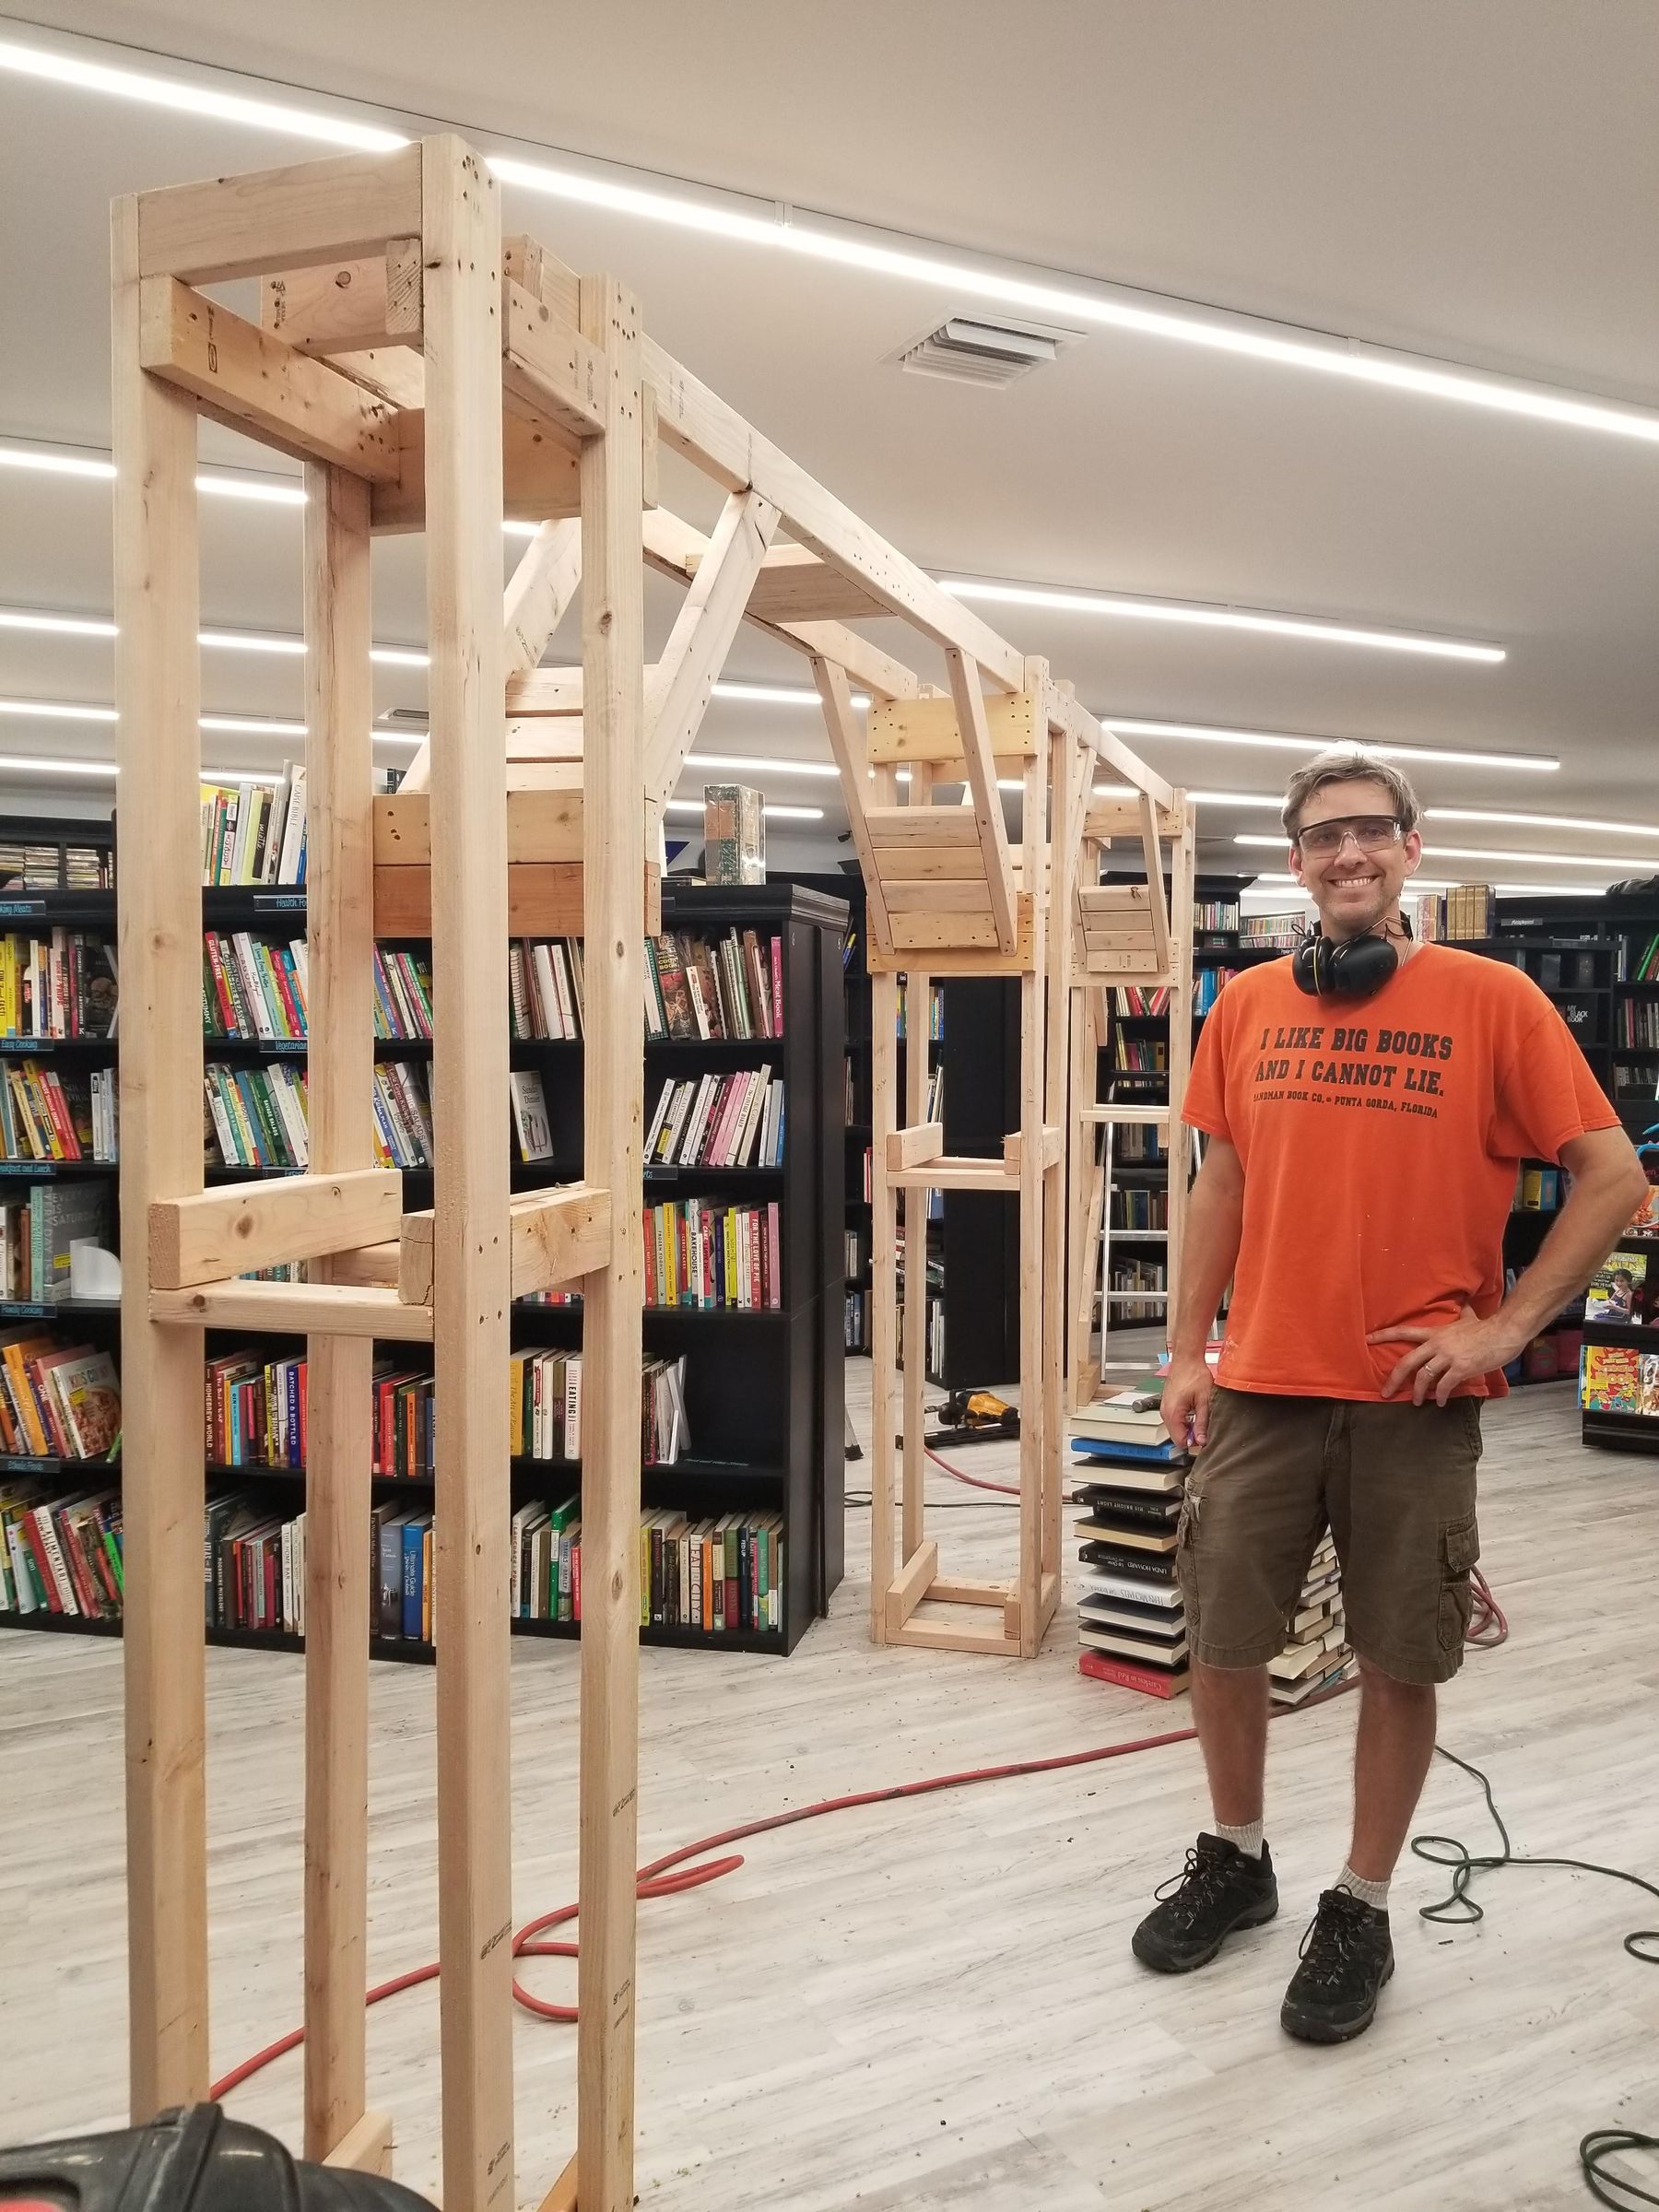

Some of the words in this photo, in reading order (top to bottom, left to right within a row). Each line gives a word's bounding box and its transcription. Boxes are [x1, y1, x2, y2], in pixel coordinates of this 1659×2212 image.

[276, 898, 298, 908] Health
[206, 939, 222, 981] GLUTEN-FREE
[772, 981, 782, 998] Meat
[235, 1003, 244, 1021] EASY
[773, 999, 784, 1018] Book
[1261, 1029, 1270, 1050] I
[1275, 1028, 1324, 1050] LIKE
[1331, 1028, 1369, 1052] BIG
[1376, 1030, 1453, 1060] BOOKS
[1255, 1060, 1290, 1082] AND
[1296, 1060, 1305, 1079] I
[1312, 1061, 1397, 1088] CANNOT
[1404, 1068, 1444, 1097] LIE.
[406, 1093, 415, 1109] BIG
[1287, 1091, 1308, 1101] BOOK
[1312, 1093, 1324, 1103] CO.
[1335, 1096, 1362, 1107] PUNTA
[1366, 1099, 1397, 1112] GORDA,
[1401, 1102, 1438, 1118] FLORIDA
[264, 1099, 273, 1118] SAVAGE
[269, 1117, 278, 1136] SALADS
[410, 1109, 426, 1141] SALADS
[753, 1263, 759, 1272] OF
[1126, 1561, 1151, 1571] HOWARD
[1151, 1566, 1168, 1574] LINDA
